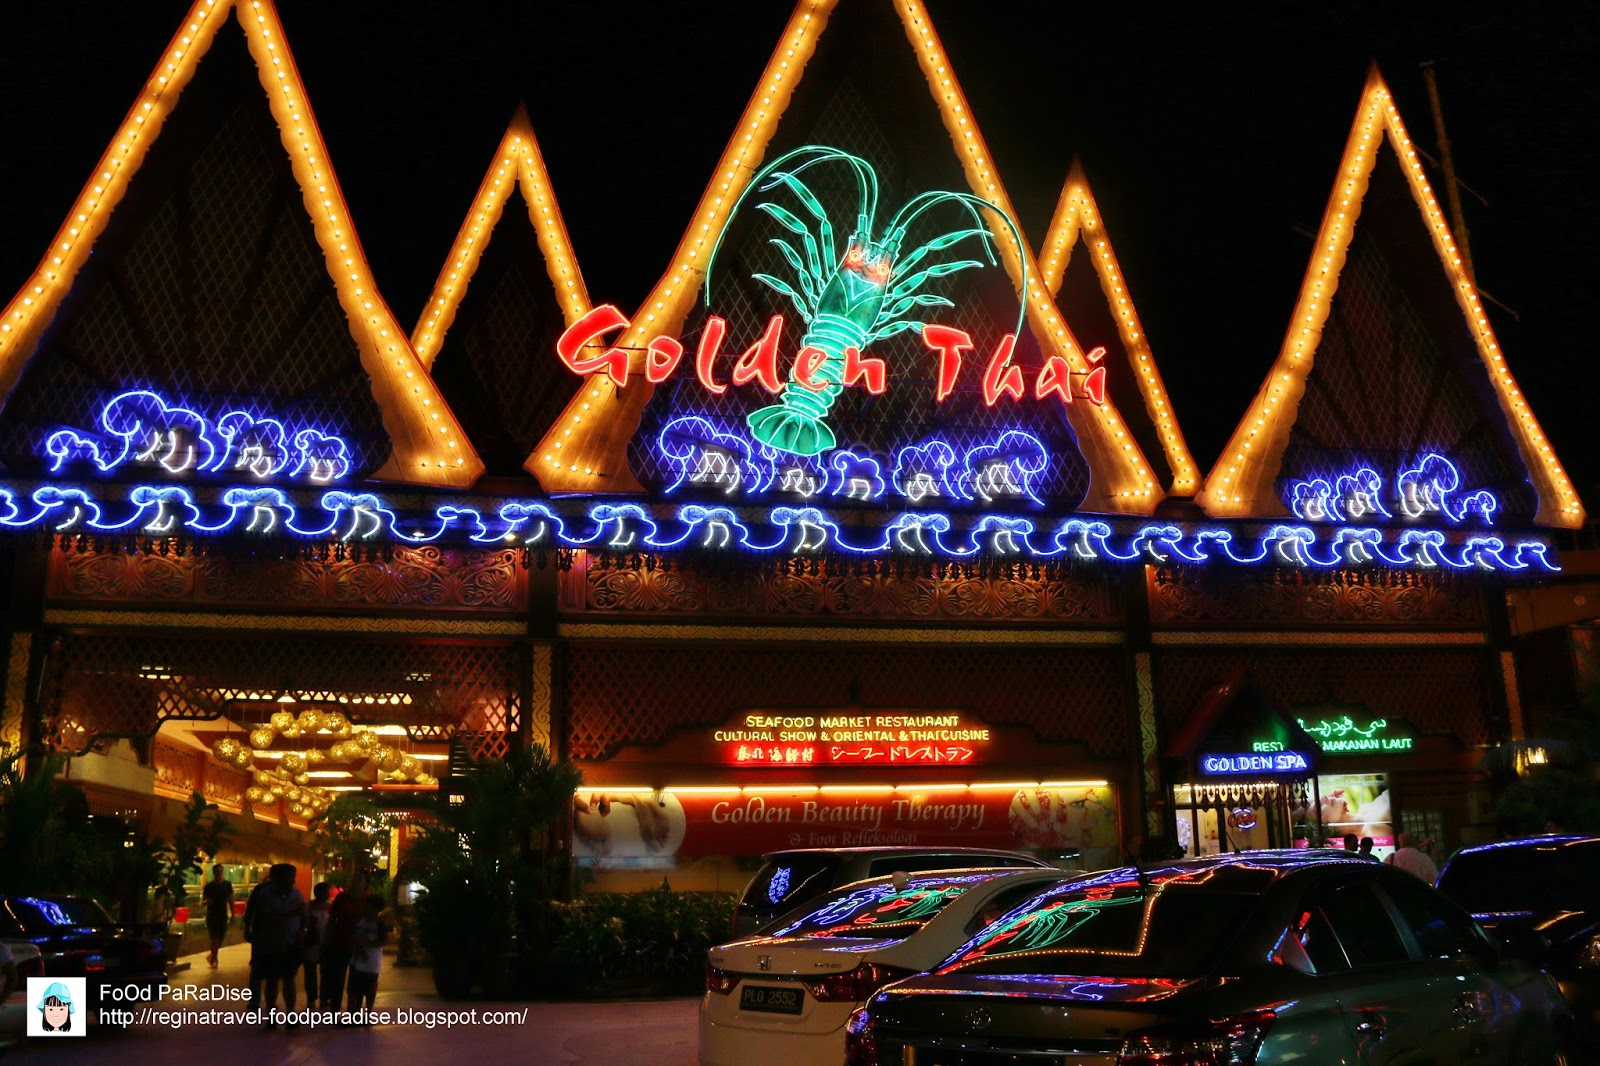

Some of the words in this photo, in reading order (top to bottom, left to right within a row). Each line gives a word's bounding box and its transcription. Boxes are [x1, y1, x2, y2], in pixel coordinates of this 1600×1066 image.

[556, 304, 886, 394] Golden
[921, 324, 1107, 406] Thai
[745, 715, 815, 728] SEAFOOD
[820, 716, 871, 729] MARKET
[875, 715, 959, 728] RESTAURANT
[714, 730, 775, 742] CULTURAL
[779, 731, 817, 742] SHOW
[820, 731, 831, 741] &
[833, 730, 896, 742] ORIENTAL
[899, 730, 909, 741] &
[1322, 739, 1379, 751] MAKANAN
[1382, 738, 1413, 750] LAUT
[1206, 756, 1273, 772] GOLDEN
[1275, 754, 1307, 770] SPA
[711, 796, 791, 824] Golden
[801, 800, 883, 831] Beauty
[892, 796, 986, 831] Therapy
[809, 832, 837, 846] Foot
[767, 991, 797, 1006] 2552
